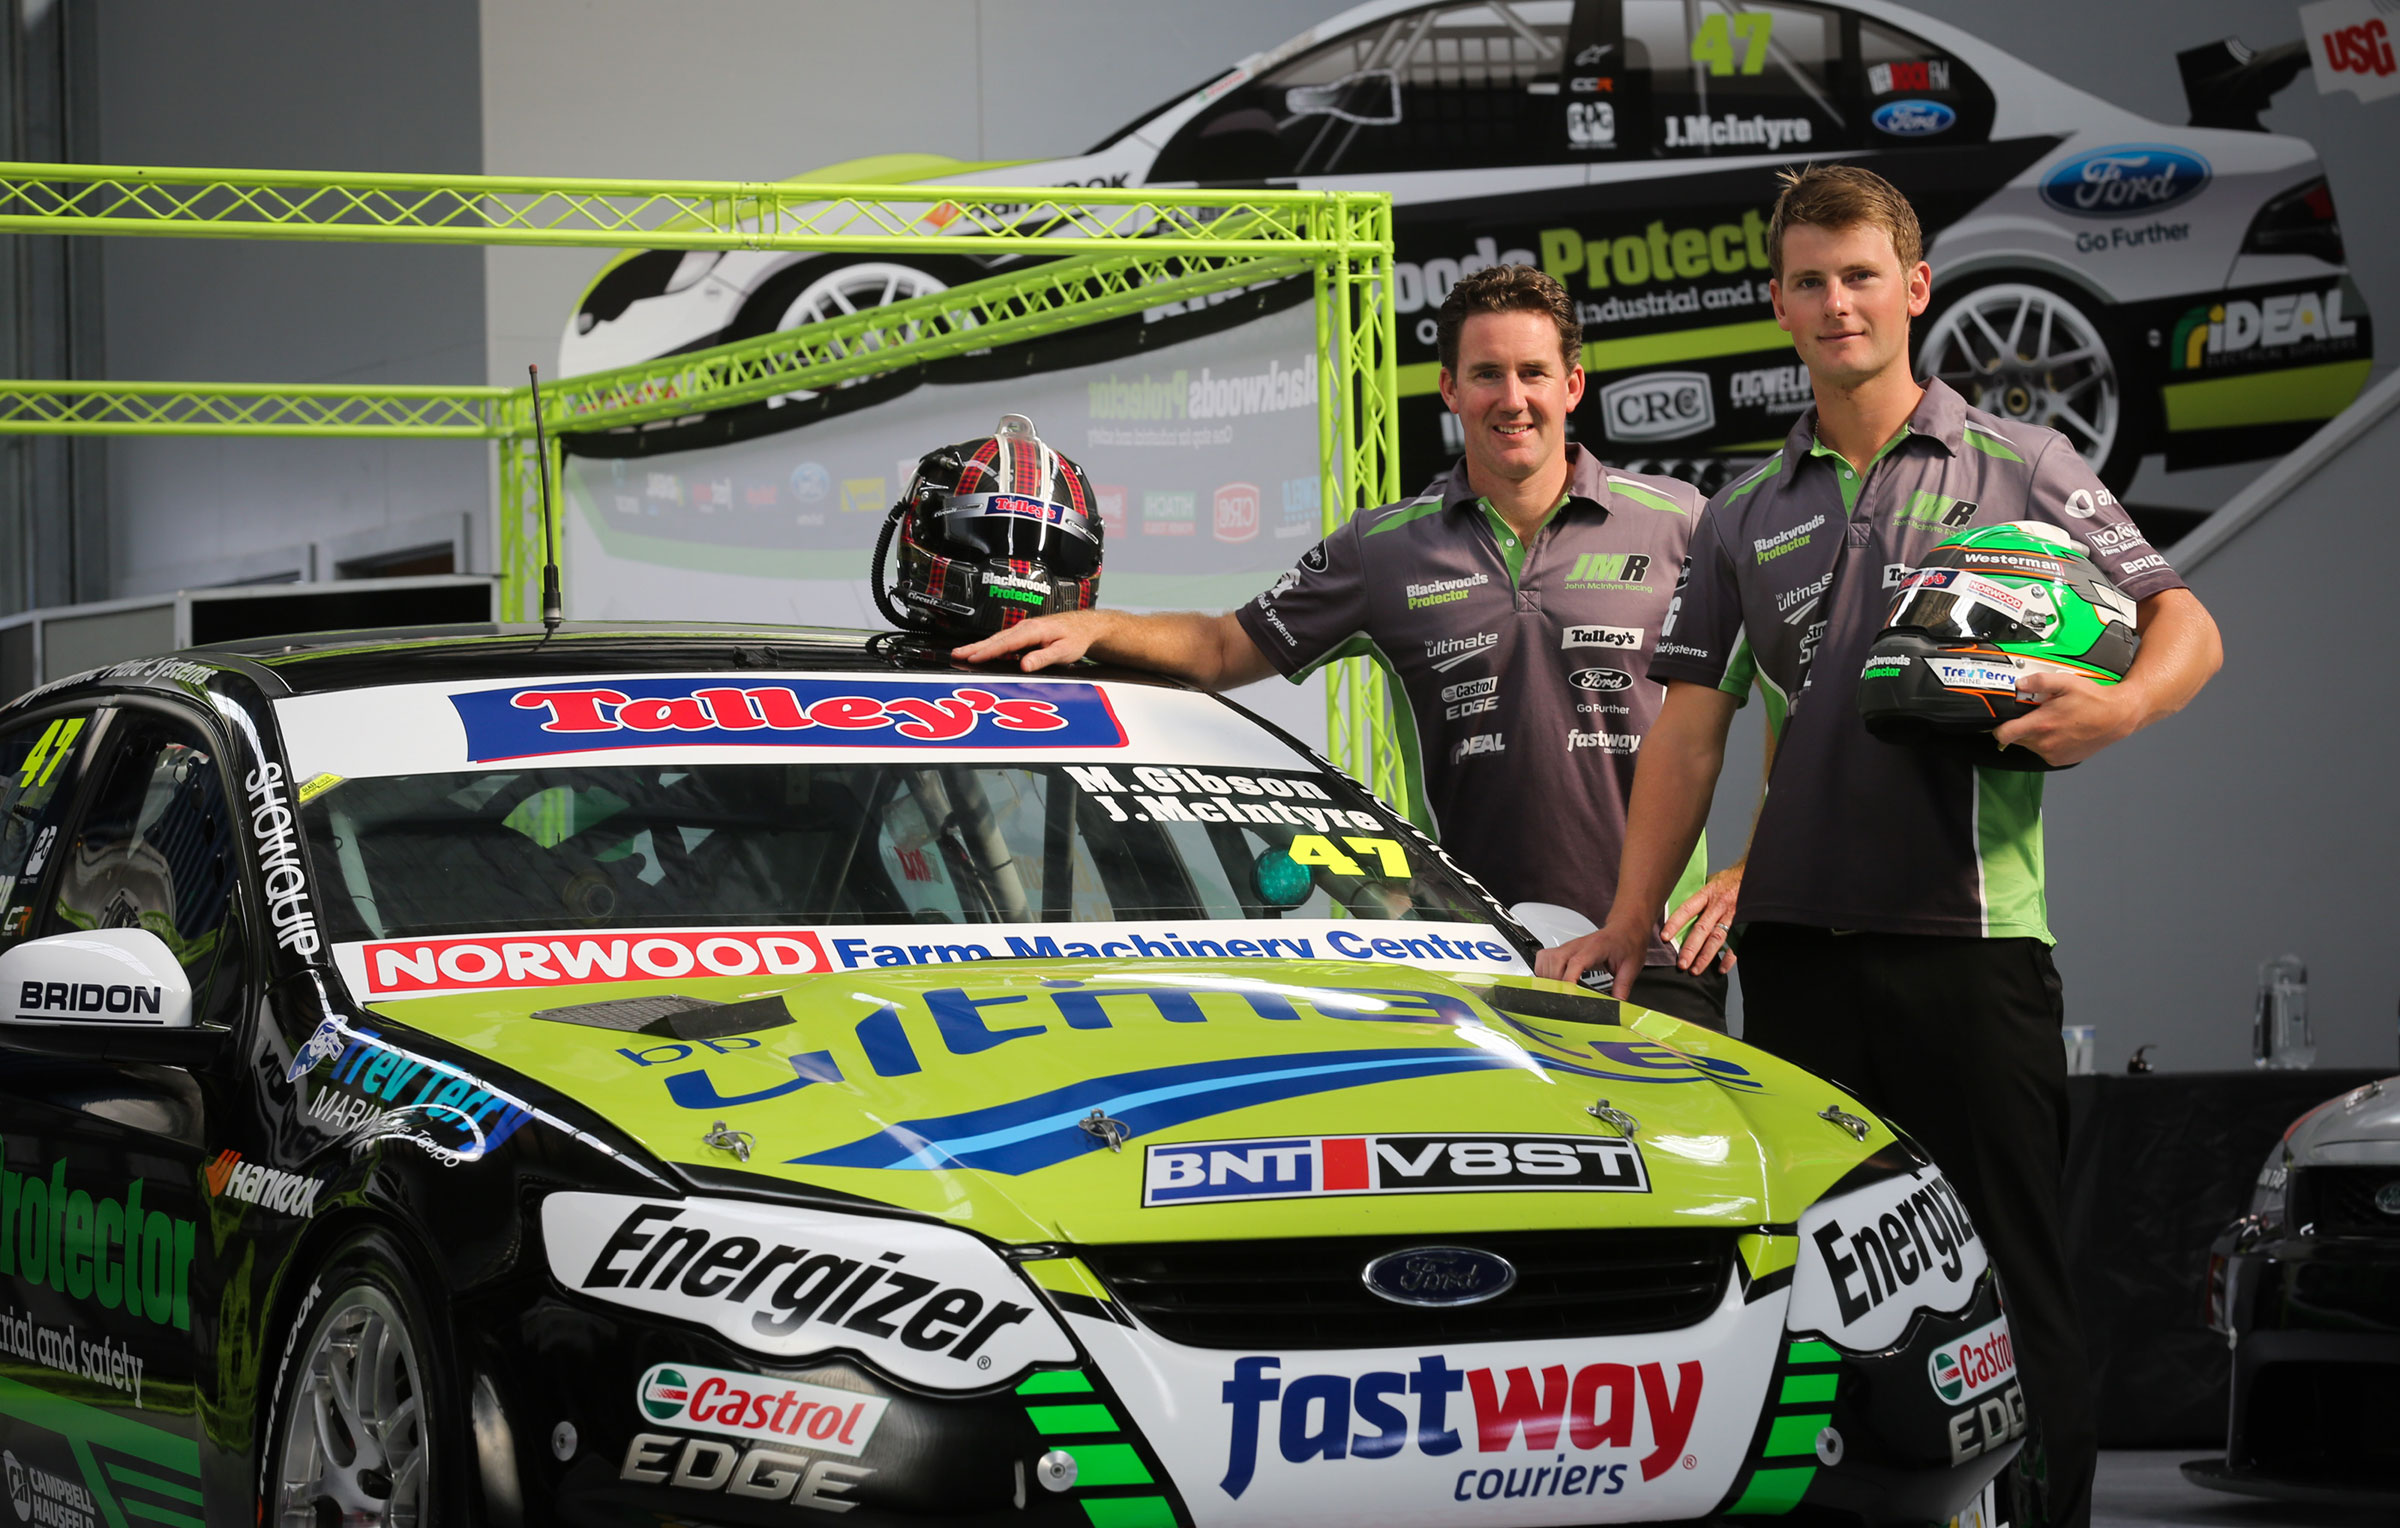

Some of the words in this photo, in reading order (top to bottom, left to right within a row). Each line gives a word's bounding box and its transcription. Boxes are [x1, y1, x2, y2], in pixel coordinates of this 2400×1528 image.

[1692, 13, 1772, 76] 47
[1665, 113, 1812, 150] J.McIntyre
[2075, 156, 2180, 207] Ford
[1539, 209, 1770, 290] Protect
[2077, 233, 2107, 253] Go
[2111, 222, 2190, 249] Further
[1703, 280, 1757, 311] and
[1617, 384, 1707, 426] CRC
[995, 497, 1056, 520] Talley's
[1753, 514, 1825, 553] Blackwoods
[1757, 534, 1811, 566] Protector
[2091, 524, 2142, 547] NORW
[1565, 553, 1652, 583] JMR
[1965, 553, 2061, 572] Westerman
[981, 572, 1052, 595] Blackwoods
[989, 585, 1044, 606] Protector
[1406, 572, 1489, 598] Blackwoods
[1408, 589, 1469, 611] Protector
[1565, 582, 1586, 591] John
[1587, 582, 1625, 591] McIntyre
[1625, 583, 1653, 593] Racing
[1779, 572, 1833, 612] ultimae
[1970, 580, 2022, 608] NORWOOD
[1265, 607, 1298, 648] Systems
[1427, 632, 1499, 658] ultimate
[1571, 629, 1635, 646] Talley's
[1456, 679, 1493, 698] Castrol
[1581, 670, 1623, 688] Ford
[1942, 666, 1975, 677] Trev
[1977, 668, 2016, 685] Terry
[511, 686, 1070, 742] Talley's
[1446, 696, 1500, 720] EDGE
[1577, 703, 1592, 713] Go
[1593, 703, 1630, 714] Further
[20, 717, 86, 789] 47
[1460, 732, 1506, 757] DEAL
[1567, 728, 1641, 753] fastway
[1062, 766, 1332, 802] M.Gibson
[1095, 795, 1385, 834] J.McIntyre
[246, 762, 320, 956] SHOWQUIP
[1288, 834, 1412, 878] 47
[373, 934, 819, 990] NORWOOD
[832, 938, 991, 967] Farm
[1004, 931, 1315, 959] Machinery
[1326, 930, 1513, 962] Centre
[19, 980, 162, 1014] BRIDON
[616, 1035, 762, 1067] bp
[307, 1084, 392, 1136] MARIN
[330, 1026, 423, 1102] Trev
[415, 1060, 537, 1156] Terry
[1151, 1147, 1312, 1188] BNT
[1377, 1142, 1633, 1178] V8ST
[225, 1160, 325, 1219] Hankook
[581, 1202, 1036, 1362] Energizer
[1400, 1253, 1481, 1293] Ford
[37, 1325, 78, 1375] and
[81, 1336, 144, 1409] safety
[688, 1376, 866, 1446] Castrol
[1219, 1354, 1705, 1501] fastway
[1950, 1384, 2028, 1468] EDG
[29, 1466, 96, 1516] CAMPBELL
[619, 1432, 878, 1514] EDGE
[1454, 1453, 1628, 1502] couriers
